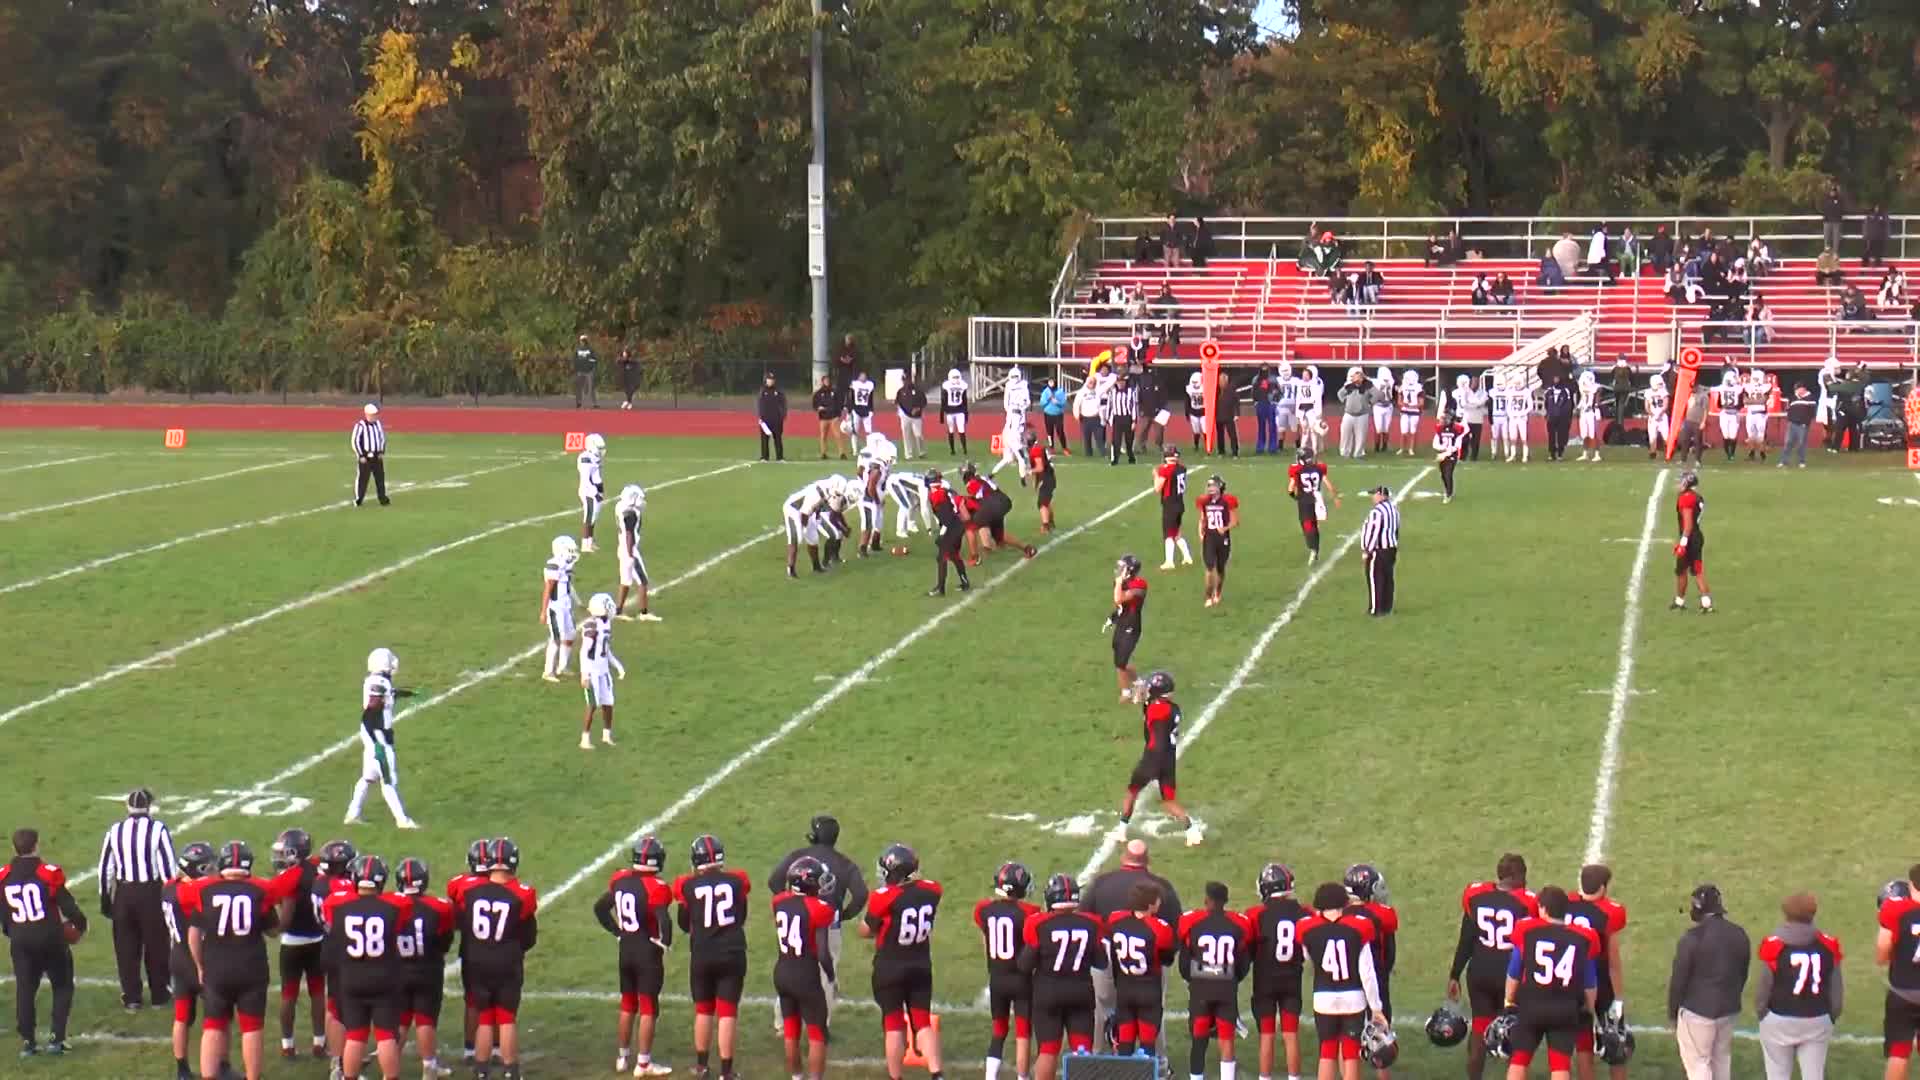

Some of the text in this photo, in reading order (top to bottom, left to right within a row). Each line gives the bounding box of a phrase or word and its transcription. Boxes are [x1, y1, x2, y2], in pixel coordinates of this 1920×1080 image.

[170, 432, 181, 444] 10
[567, 435, 581, 448] 20
[1206, 511, 1224, 530] 20
[5, 883, 45, 923] 50
[212, 894, 252, 936] 70
[472, 899, 510, 942] 67
[614, 890, 640, 932] 19
[694, 883, 736, 928] 72
[898, 903, 934, 946] 66
[344, 915, 384, 958] 58
[775, 910, 803, 956] 24
[987, 916, 1015, 960] 10
[1197, 934, 1236, 965] 30
[1275, 919, 1296, 962] 8
[1476, 906, 1516, 950] 52
[1051, 929, 1089, 972] 77
[1112, 931, 1148, 976] 25
[1321, 938, 1350, 981] 41
[1532, 940, 1577, 987] 54
[1789, 952, 1822, 996] 71
